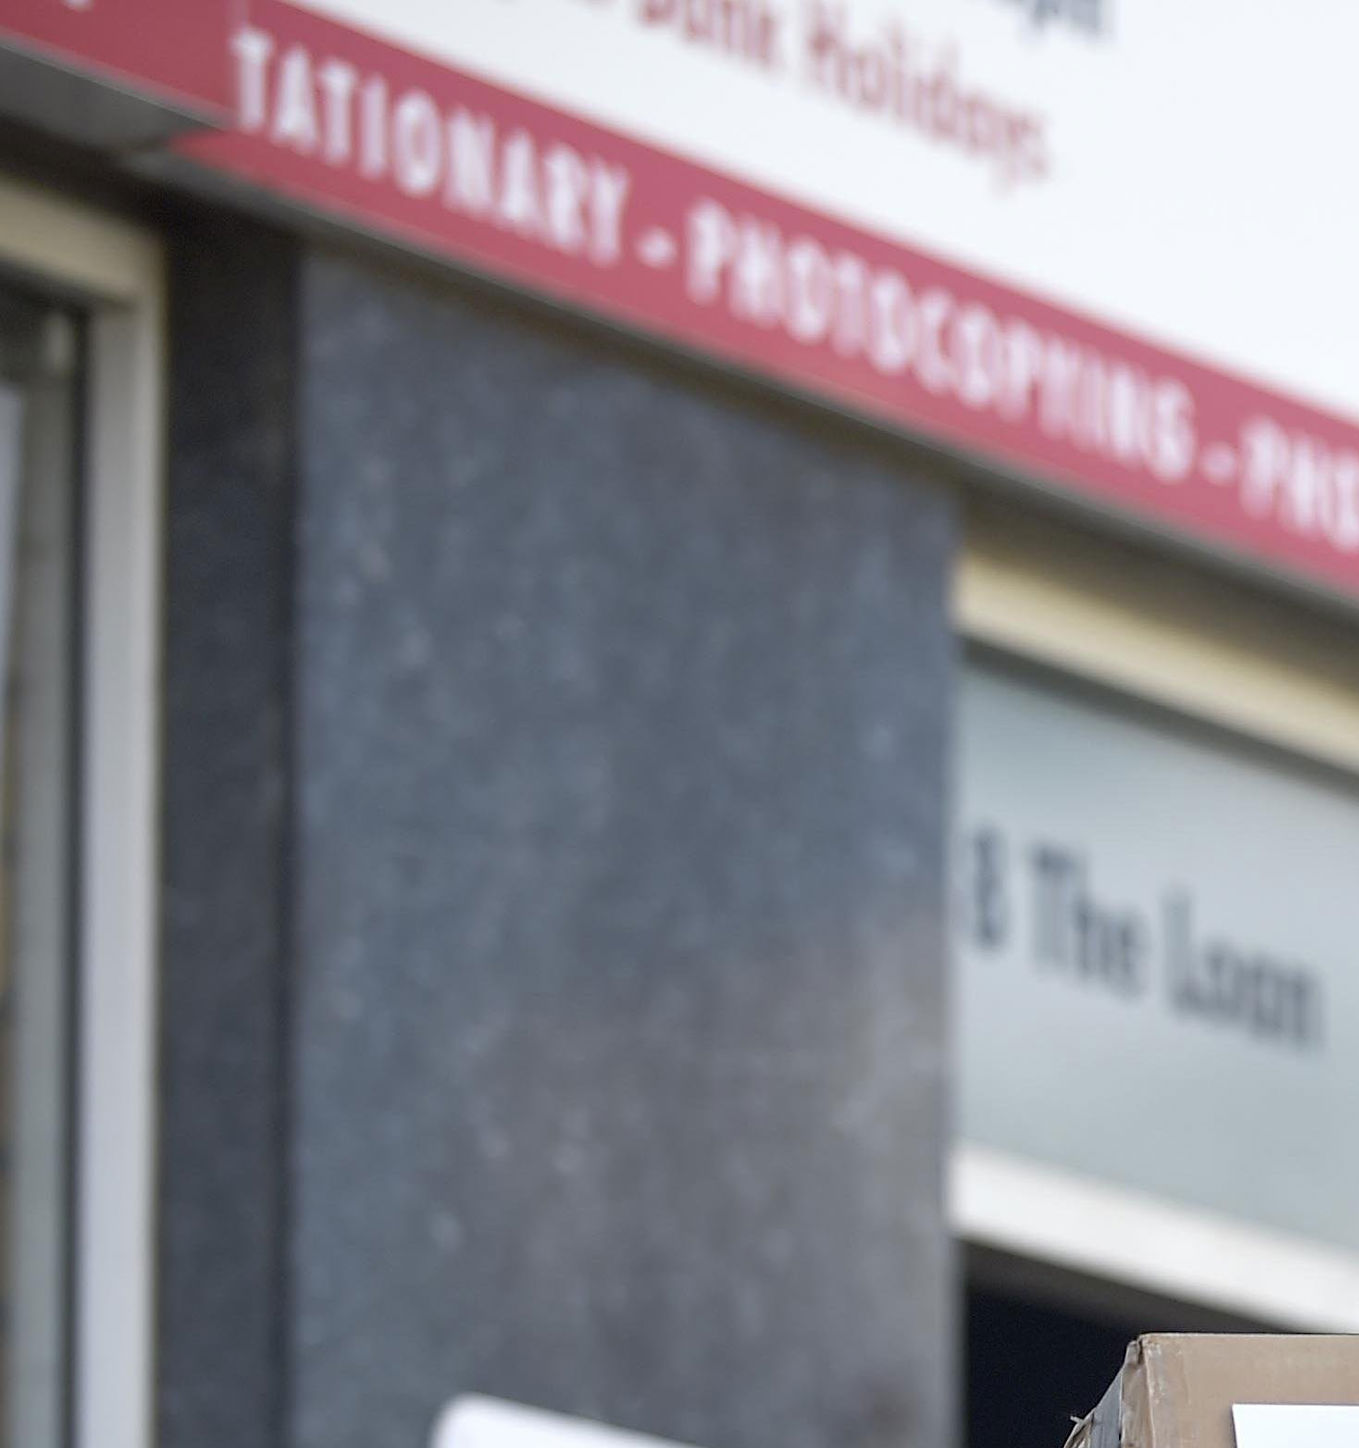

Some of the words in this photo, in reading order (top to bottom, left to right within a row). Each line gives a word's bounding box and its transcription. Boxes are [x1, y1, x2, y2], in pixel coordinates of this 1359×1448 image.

[803, 0, 1050, 194] Holidays
[229, 27, 627, 268] TATIONARY
[688, 200, 1196, 487] PHOTOCOPYING
[1027, 842, 1148, 1000] The
[1161, 885, 1328, 1055] Loan
